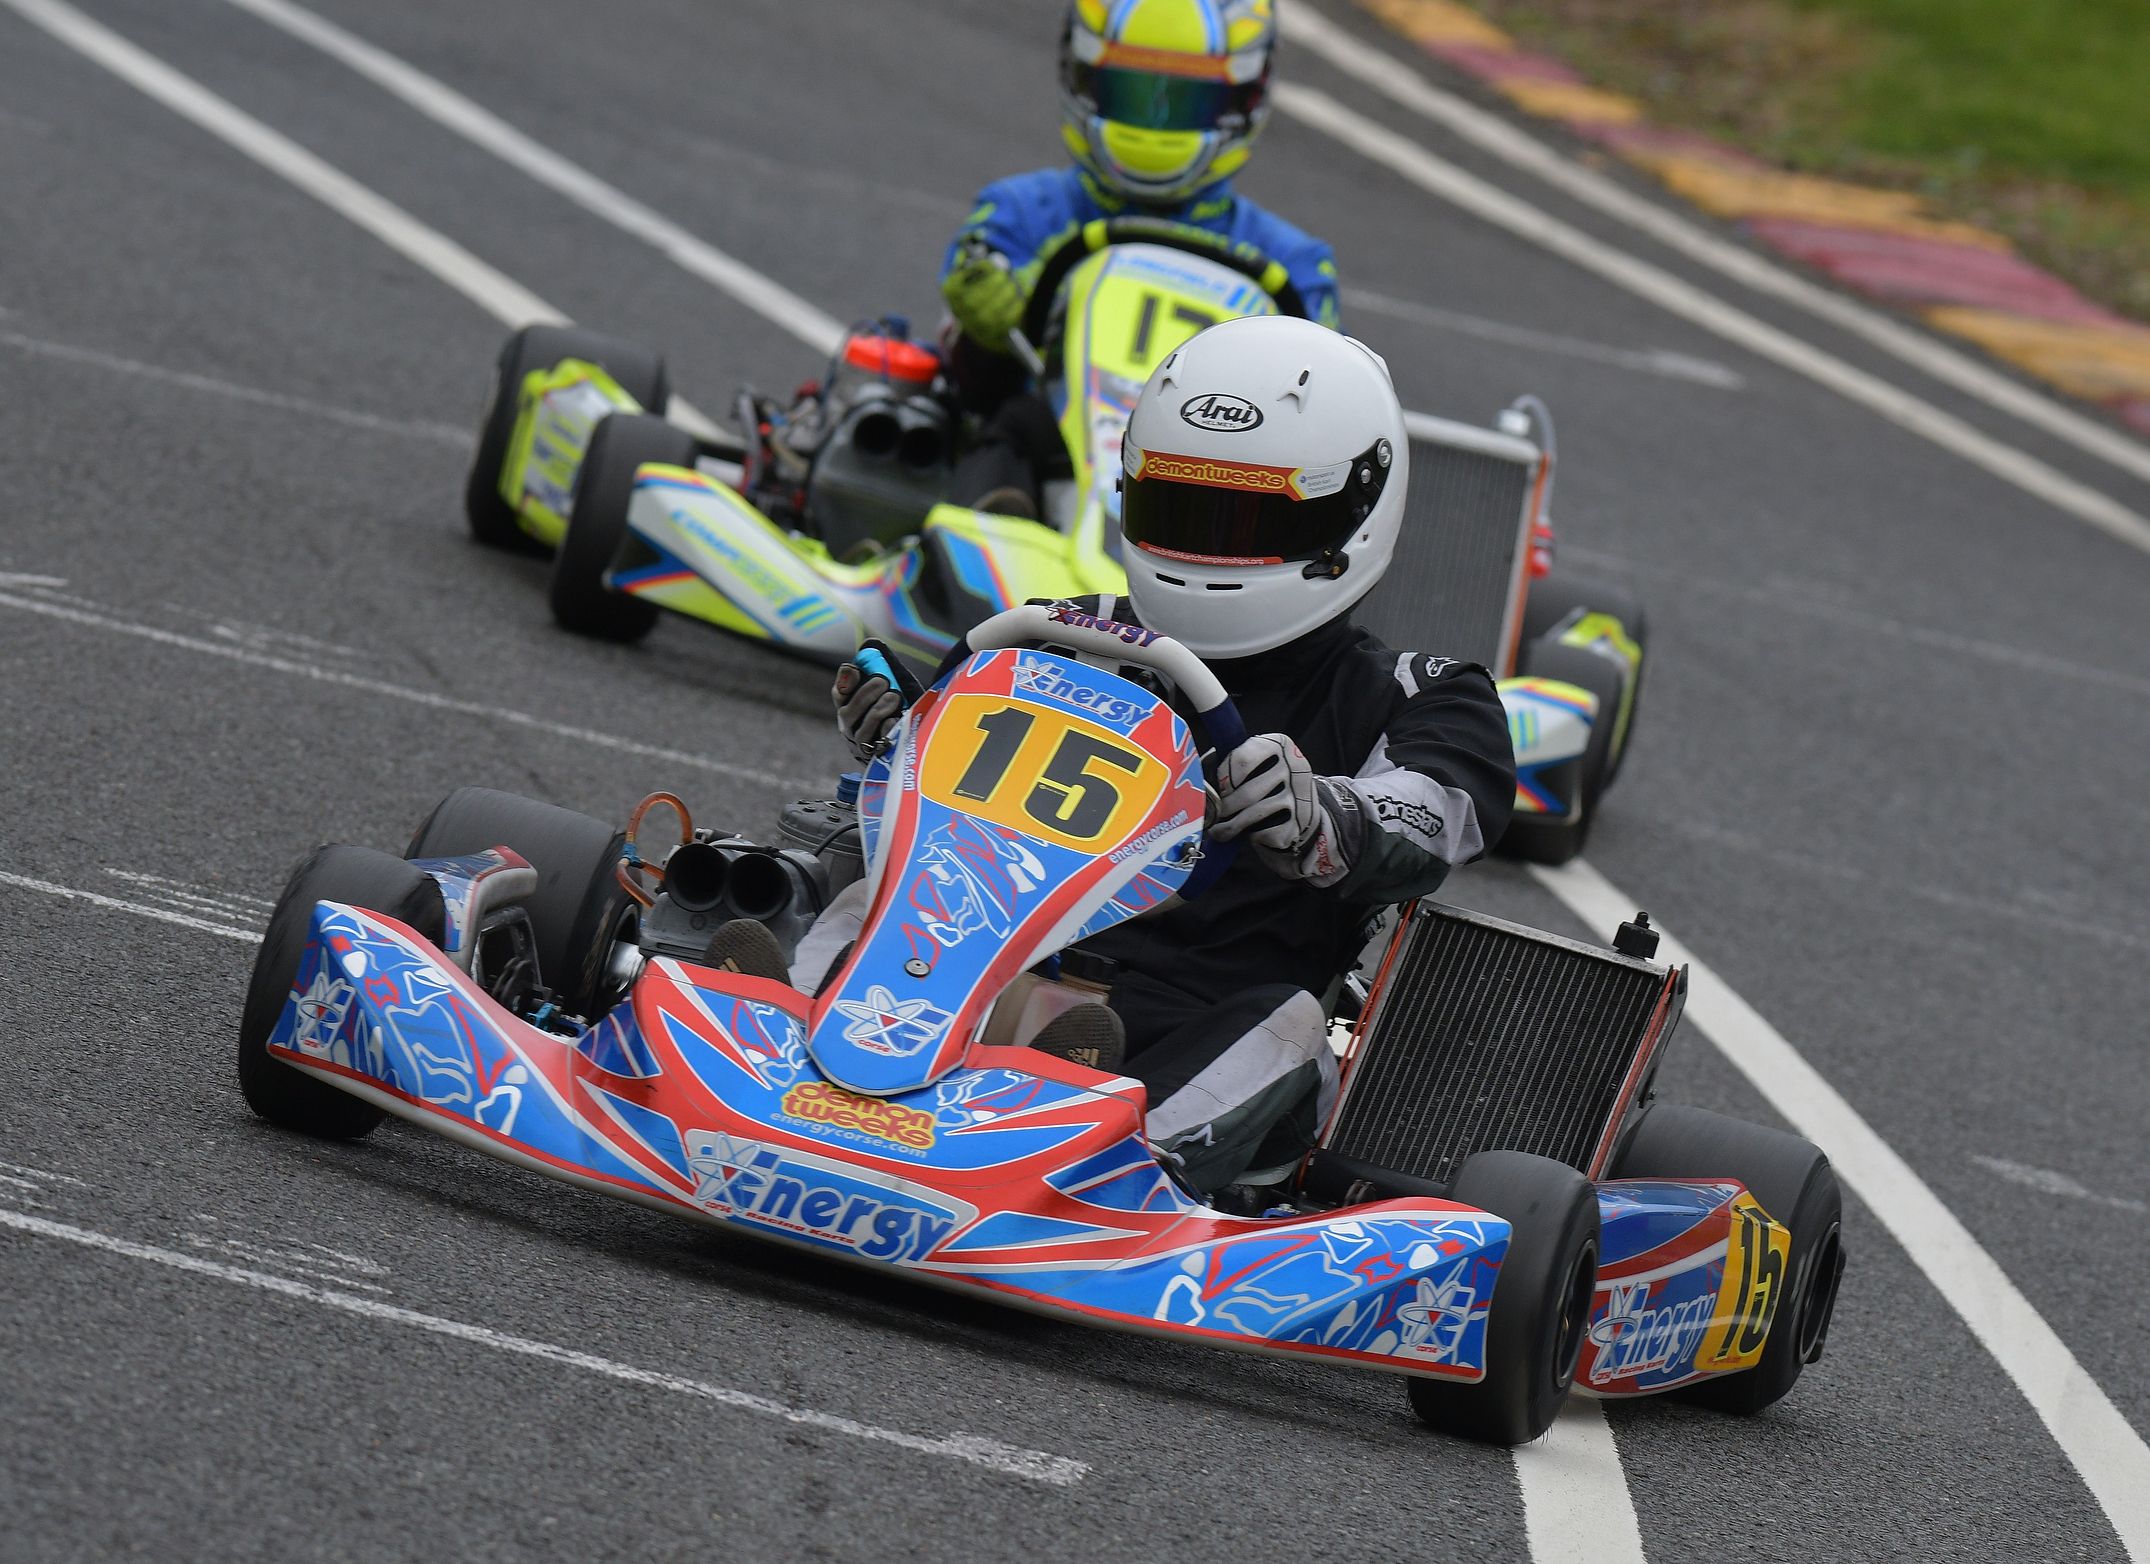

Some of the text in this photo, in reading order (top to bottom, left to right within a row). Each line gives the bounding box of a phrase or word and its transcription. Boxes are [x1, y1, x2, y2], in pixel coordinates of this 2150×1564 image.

[1184, 397, 1254, 423] Arai
[1146, 457, 1286, 489] demontweeks
[1052, 607, 1166, 648] Energy
[1016, 659, 1152, 728] Energy
[951, 704, 1147, 841] 15
[858, 1039, 890, 1054] corse
[786, 1094, 931, 1146] tweeks
[796, 1083, 932, 1129] demon
[770, 1112, 928, 1158] energycorse.com
[696, 1140, 954, 1263] Energy
[746, 1212, 855, 1244] Racing Karts
[1716, 1206, 1784, 1361] 15
[1596, 1284, 1716, 1373] Energy
